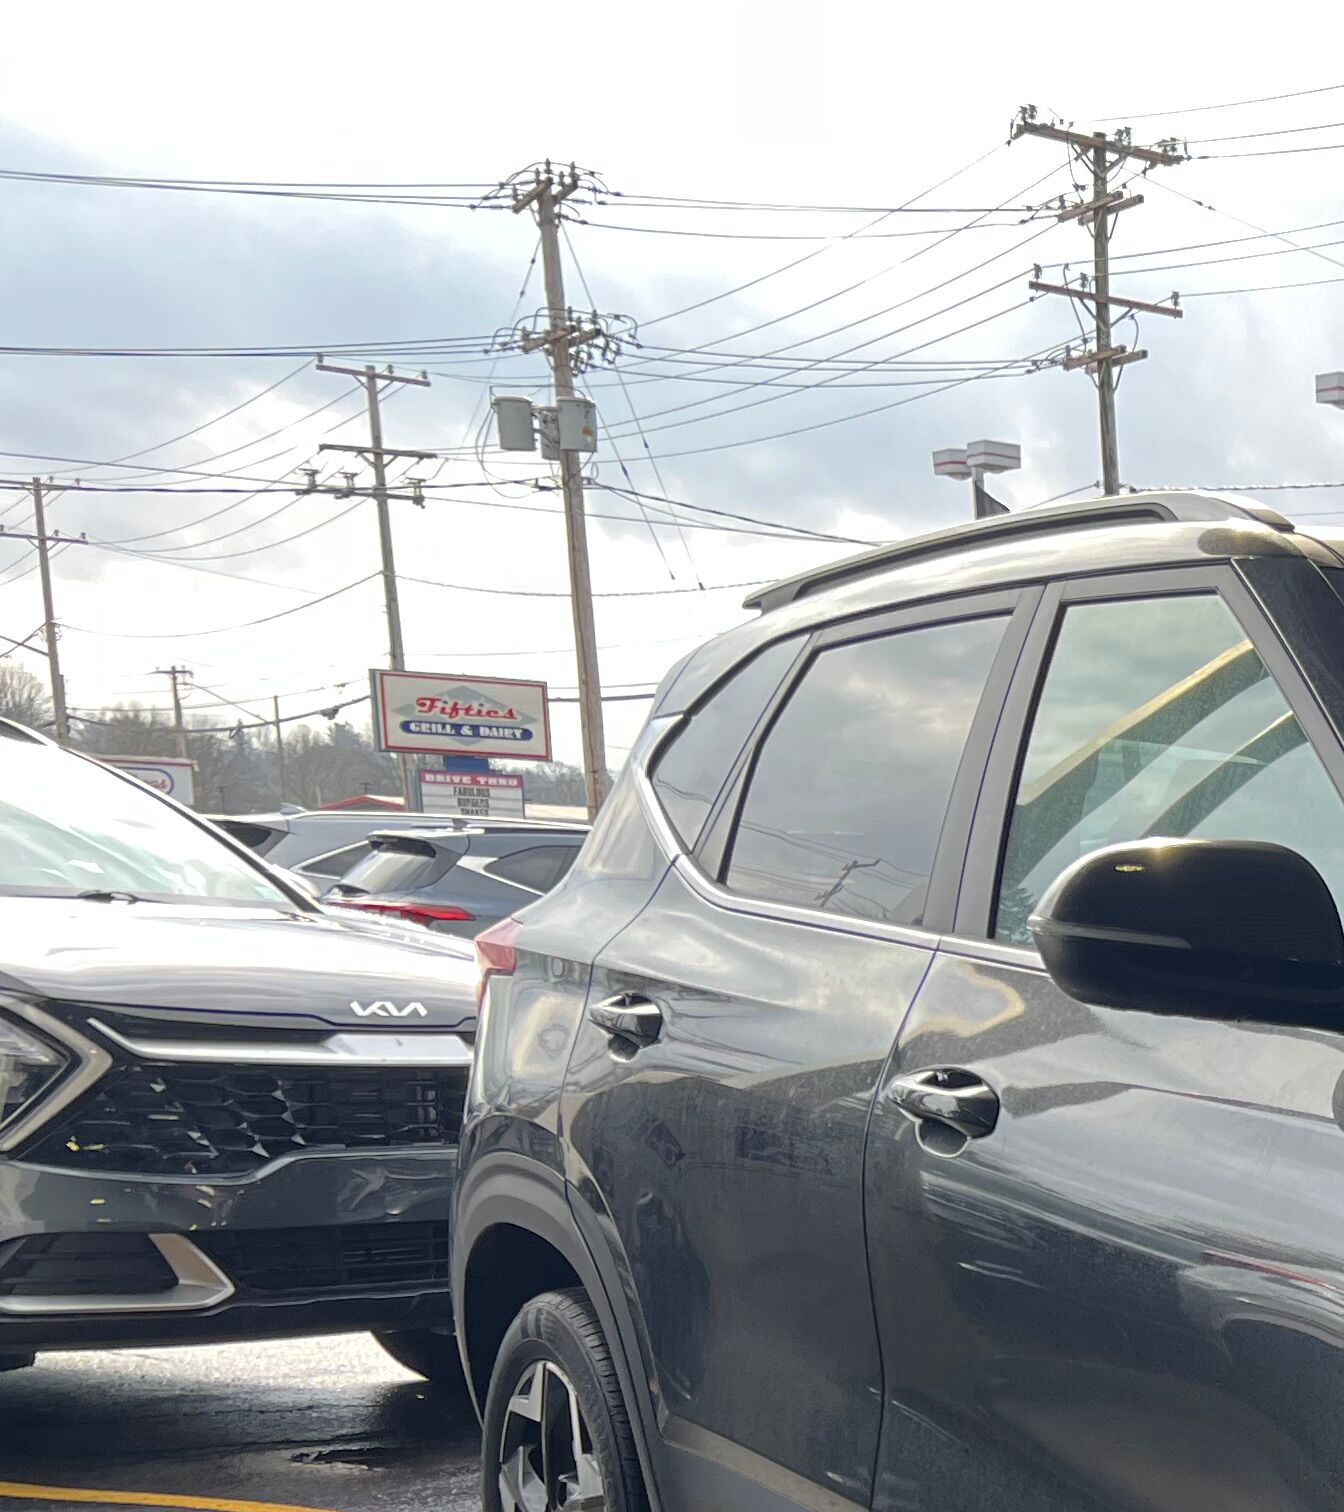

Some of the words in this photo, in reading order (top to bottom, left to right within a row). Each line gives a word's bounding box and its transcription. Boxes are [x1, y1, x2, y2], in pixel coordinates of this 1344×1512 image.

[416, 697, 517, 719] Fifties
[410, 722, 455, 735] GRILL
[460, 726, 473, 737] &
[479, 727, 523, 739] DAIRY
[425, 774, 471, 784] DRIVE
[477, 777, 517, 786] THRU
[453, 786, 490, 798] FABULOUS
[457, 798, 490, 808] BURGERS
[350, 1001, 428, 1017] KIA
